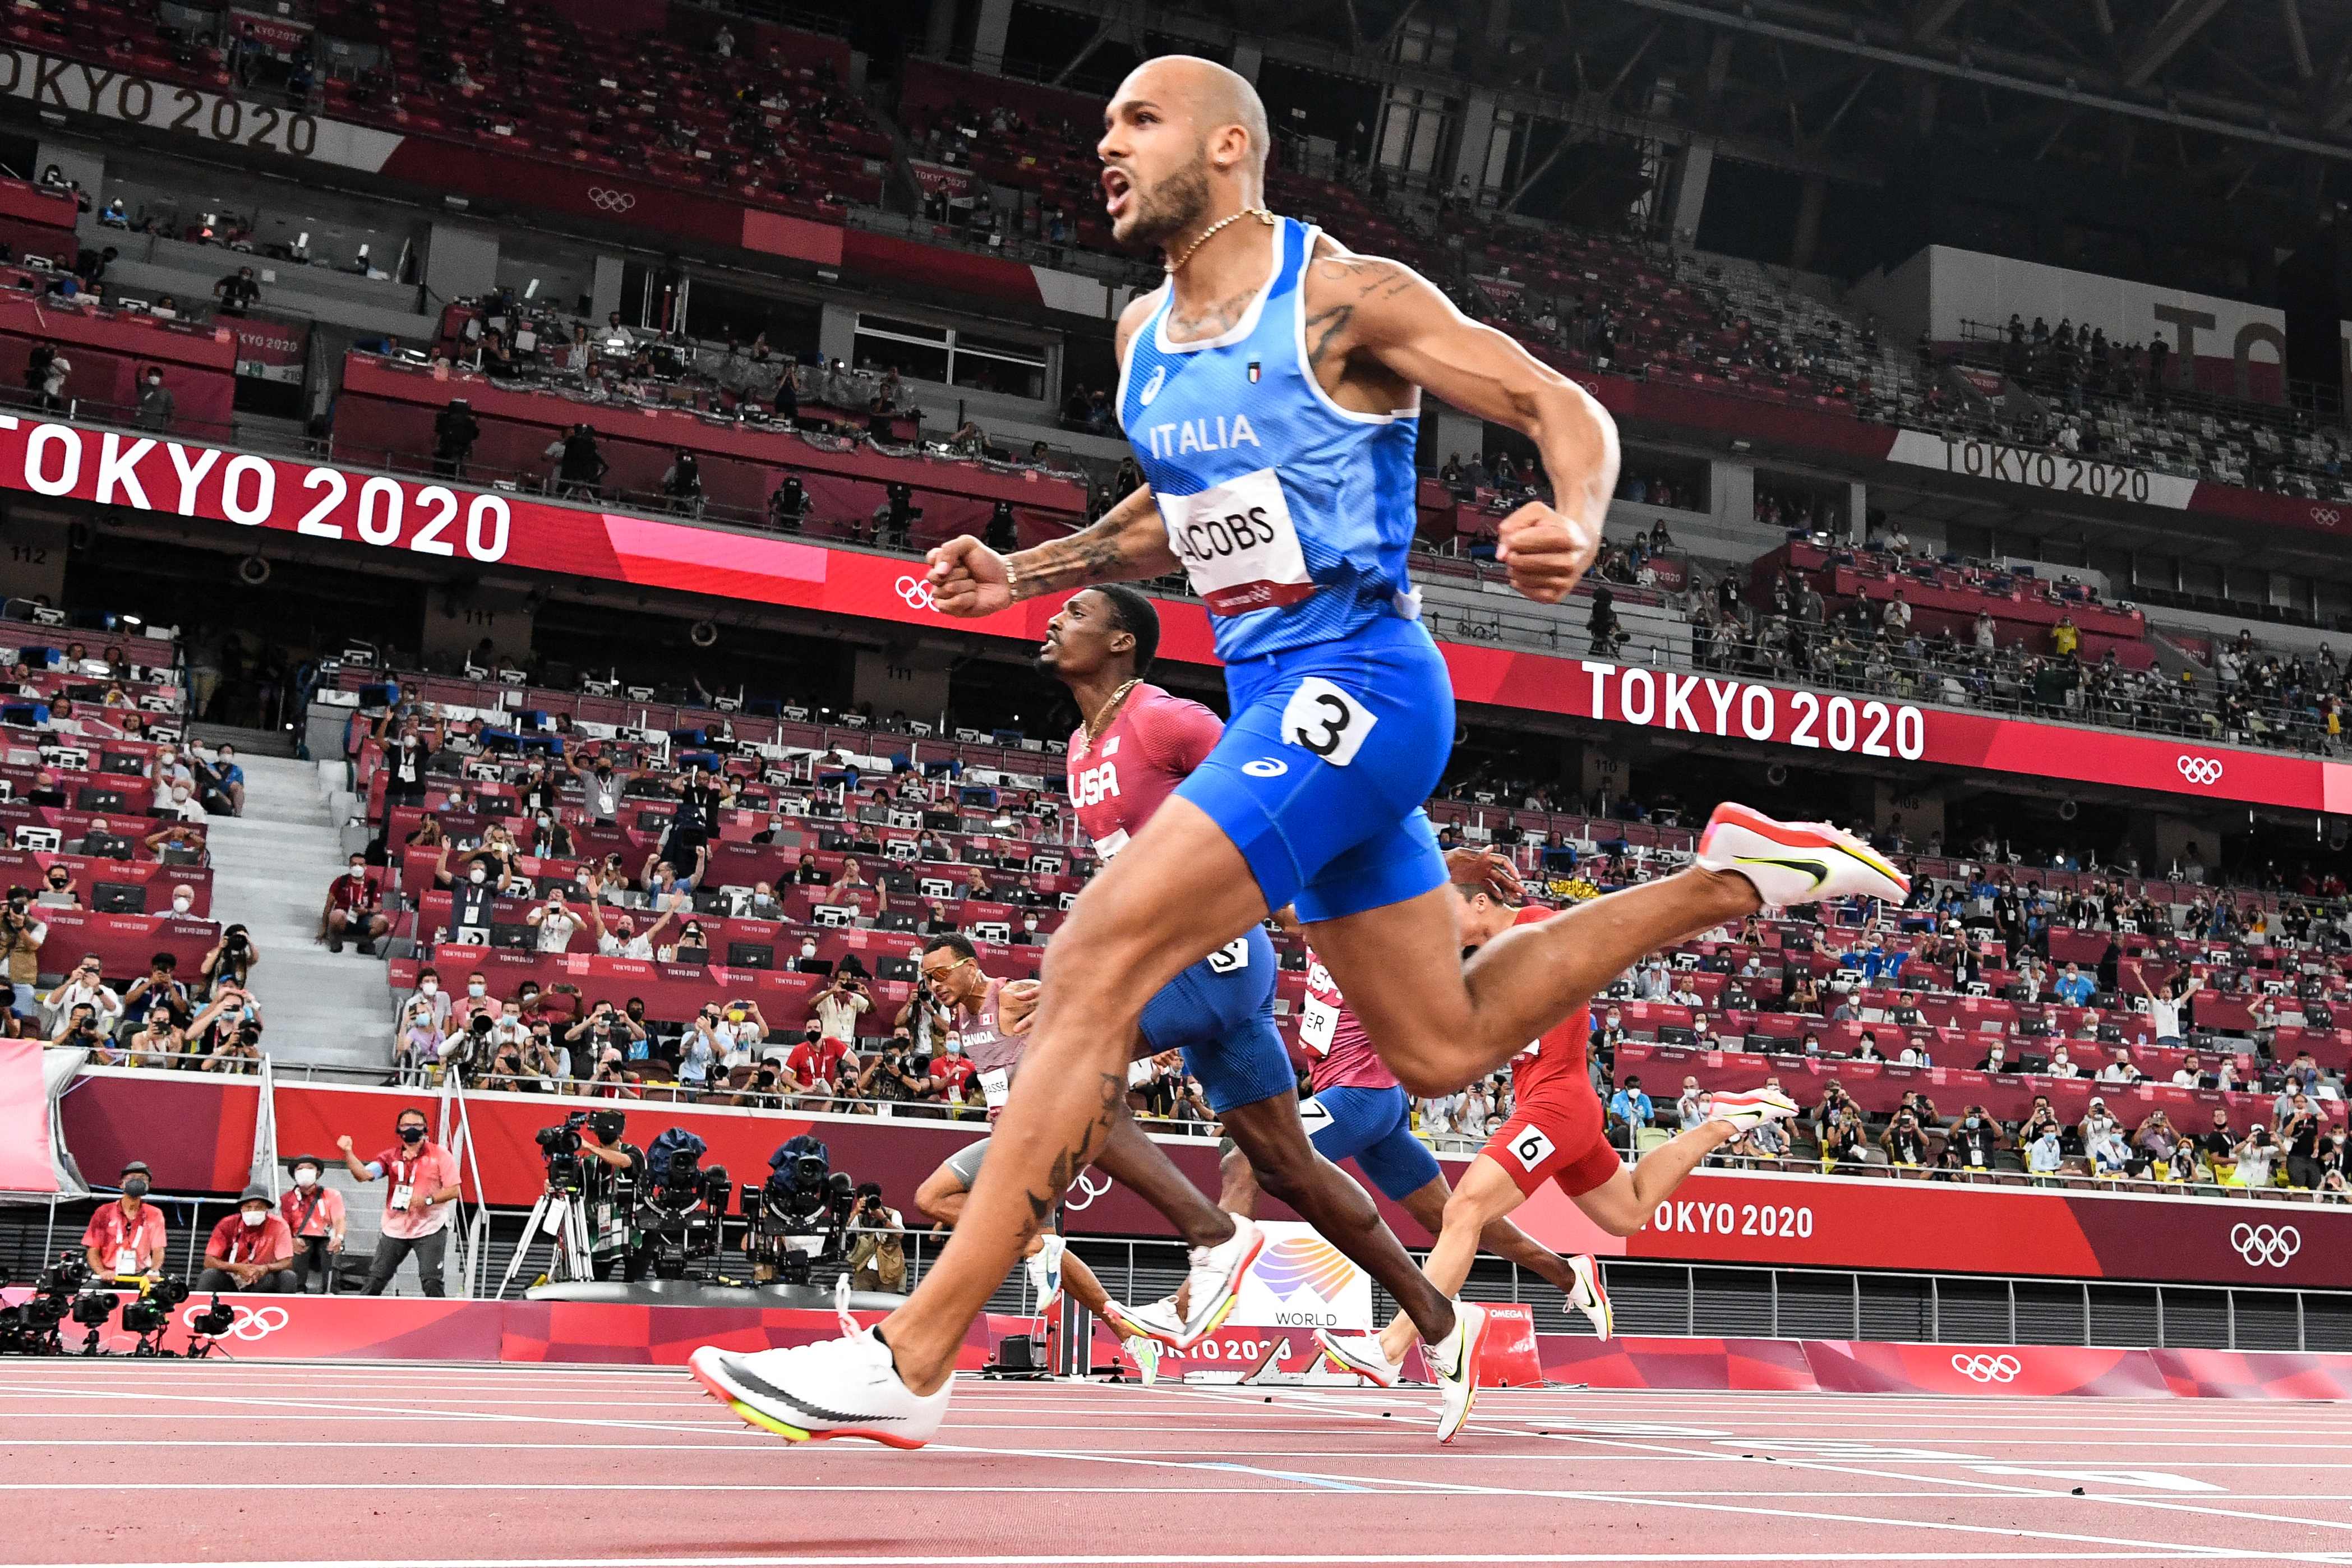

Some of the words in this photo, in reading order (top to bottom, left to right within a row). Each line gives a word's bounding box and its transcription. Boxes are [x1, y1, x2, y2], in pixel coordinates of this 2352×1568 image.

[170, 88, 317, 158] 2020
[1150, 414, 1261, 459] ITALIA
[1940, 431, 2055, 488] TOKYO
[2067, 458, 2148, 504] 2020
[297, 467, 510, 563] 2020
[11, 546, 46, 565] 112
[464, 610, 495, 626] 111
[887, 665, 912, 681] 111
[1581, 661, 1774, 741] TOKYO
[1790, 690, 1924, 760] 2020
[1297, 693, 1350, 756] 3
[1068, 761, 1121, 809] USA
[1212, 942, 1238, 968] 5
[962, 1031, 995, 1047] CANADA
[1300, 1103, 1327, 1118] 7
[1519, 1136, 1543, 1161] 6
[1640, 1200, 1735, 1235] OKYO
[1741, 1204, 1813, 1238] 2020
[1276, 1312, 1337, 1326] WORLD
[1490, 1309, 1524, 1319] OMEGA
